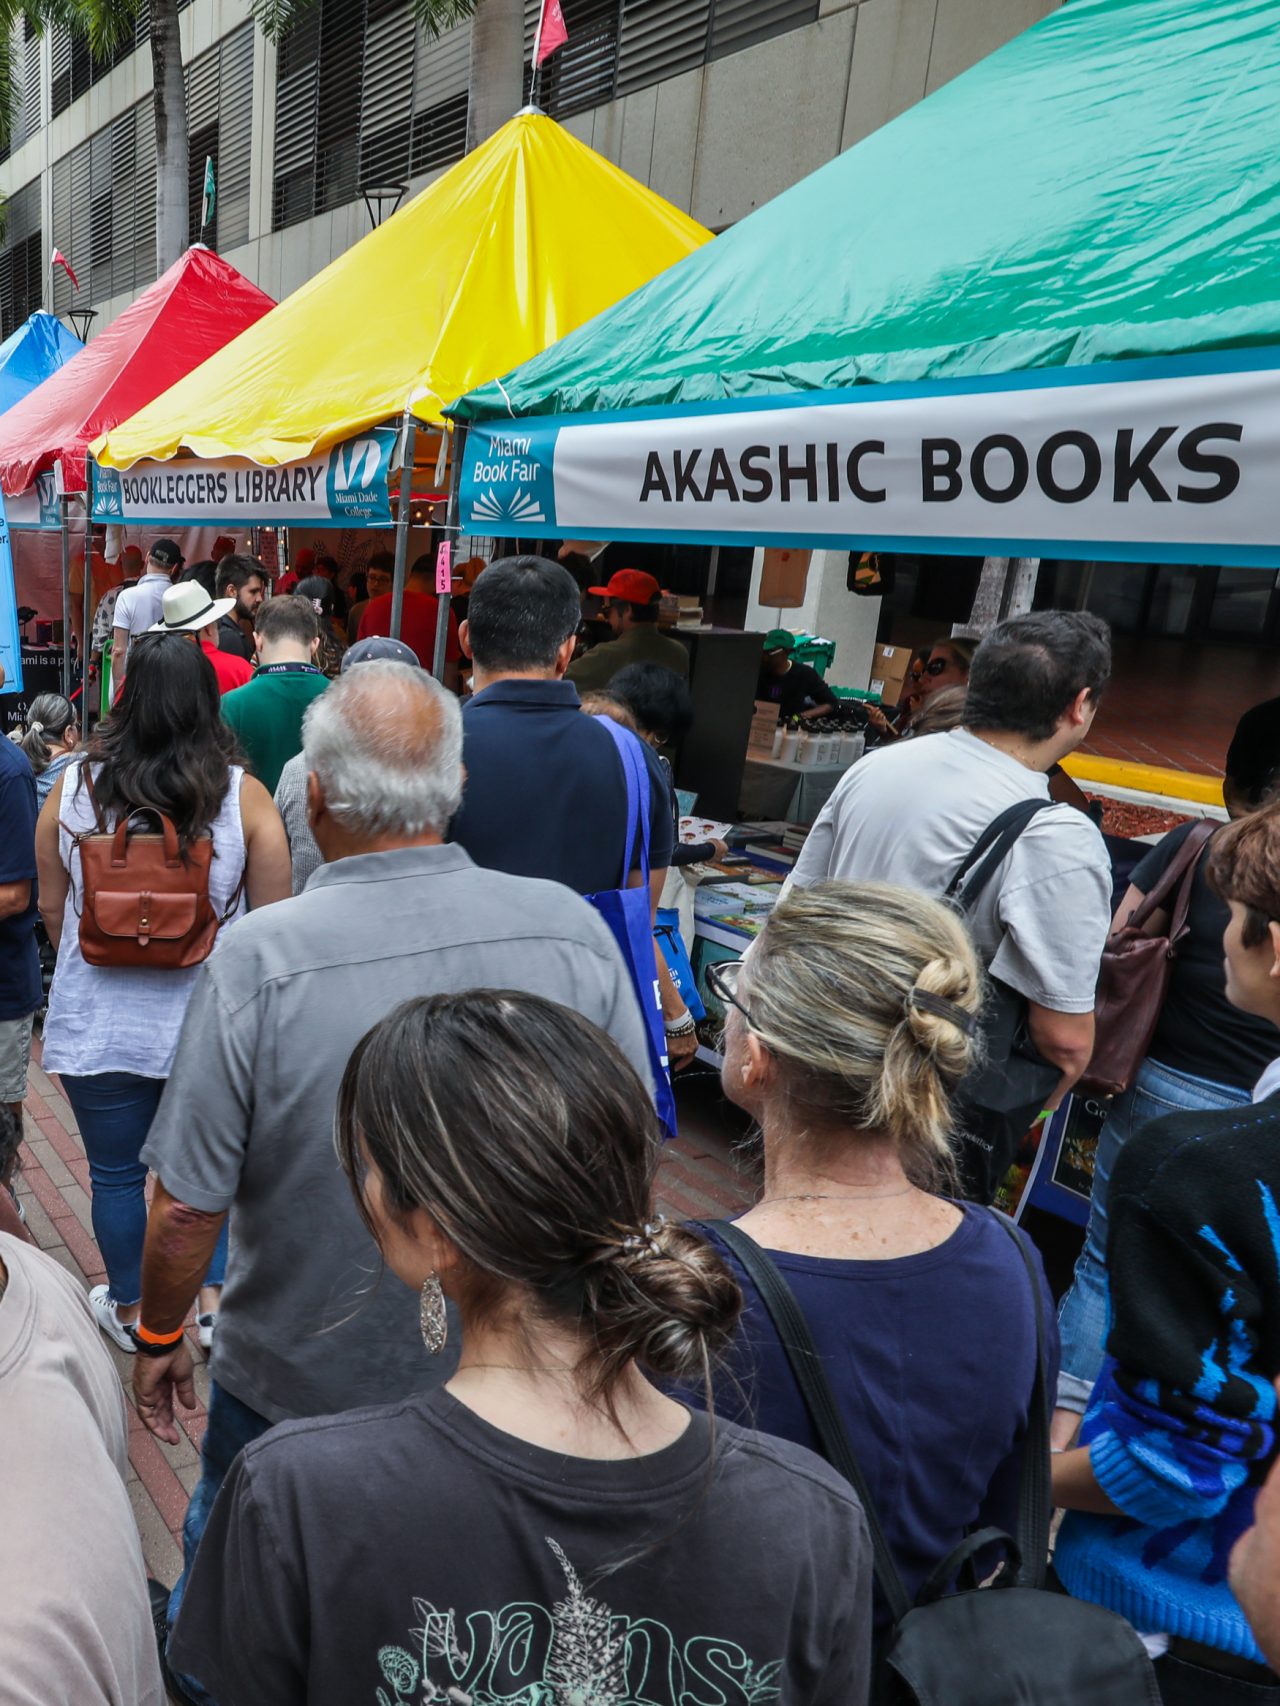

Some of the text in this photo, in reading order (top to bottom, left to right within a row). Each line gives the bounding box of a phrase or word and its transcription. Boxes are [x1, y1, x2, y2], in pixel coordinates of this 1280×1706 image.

[488, 436, 531, 457] Miami
[474, 460, 540, 483] Book Fair
[639, 422, 1244, 504] AKASHIC BOOKS
[97, 481, 117, 493] Book Fair
[123, 465, 323, 504] BOOKLEGGERS LIBRARY
[335, 491, 378, 504] Miami Dade
[345, 506, 372, 519] College
[39, 655, 48, 665] is
[49, 657, 56, 665] a
